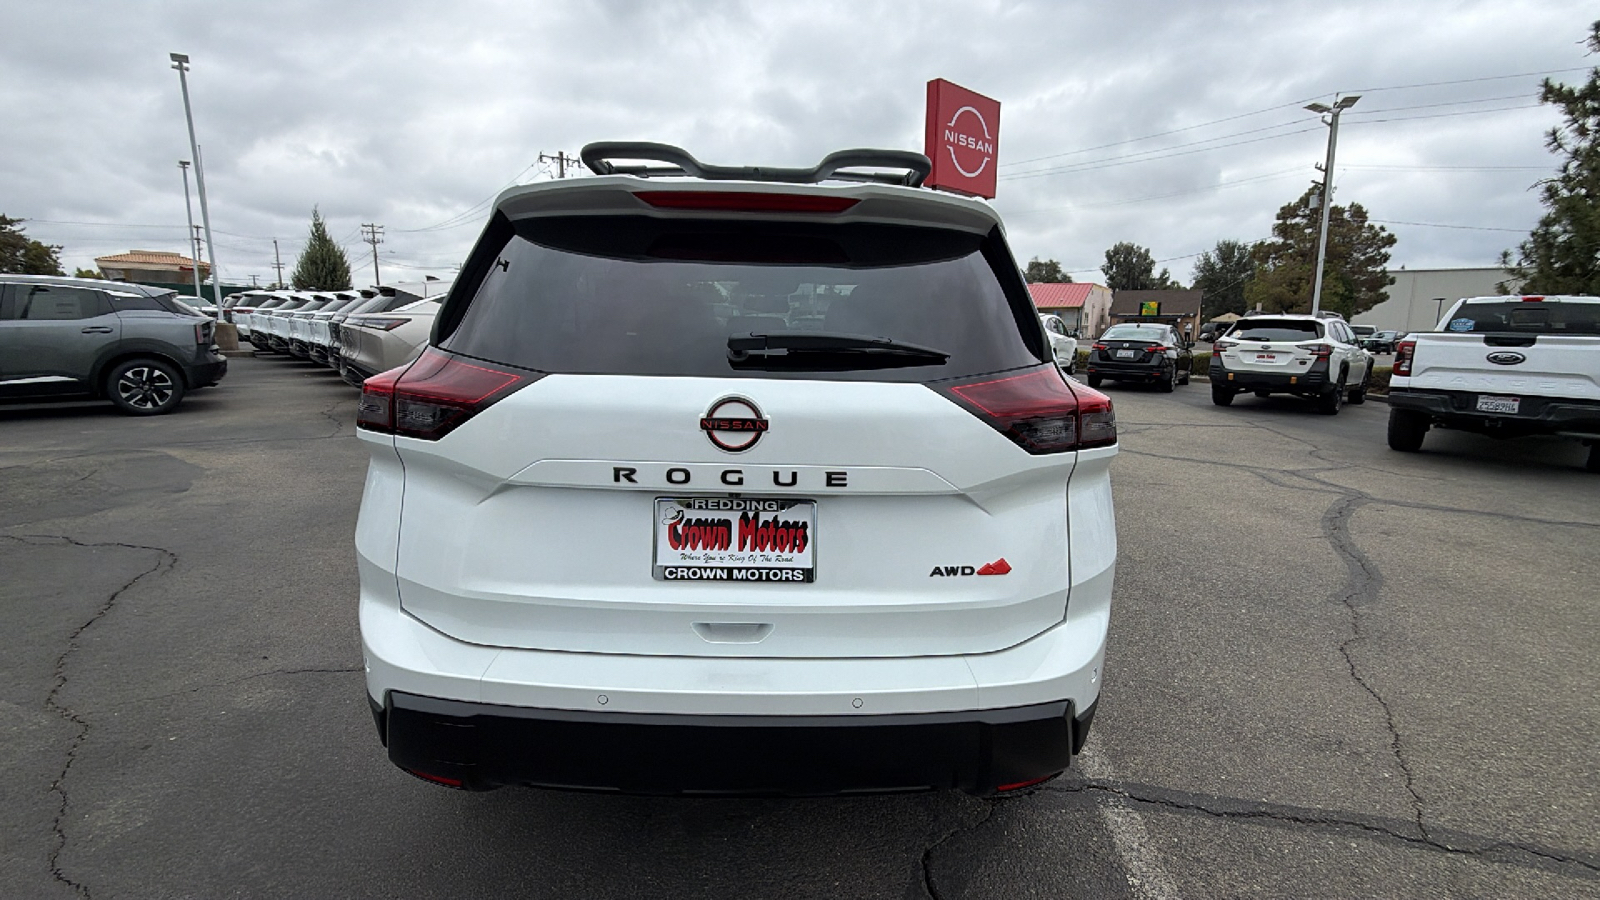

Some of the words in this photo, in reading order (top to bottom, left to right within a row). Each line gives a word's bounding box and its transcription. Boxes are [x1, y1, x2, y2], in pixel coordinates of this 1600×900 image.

[944, 129, 993, 154] NISSAN
[701, 418, 768, 430] NISSAN
[613, 466, 848, 487] ROGUE
[694, 500, 778, 511] REDDING
[667, 514, 732, 551] Crown
[738, 512, 809, 553] Motors
[680, 552, 701, 561] Where
[703, 552, 726, 564] You're
[728, 553, 746, 564] King
[748, 554, 758, 564] Of
[760, 554, 772, 562] The
[775, 554, 794, 563] Road
[664, 567, 728, 579] CROWN
[732, 568, 804, 581] MOTORS
[929, 566, 975, 577] AWD
